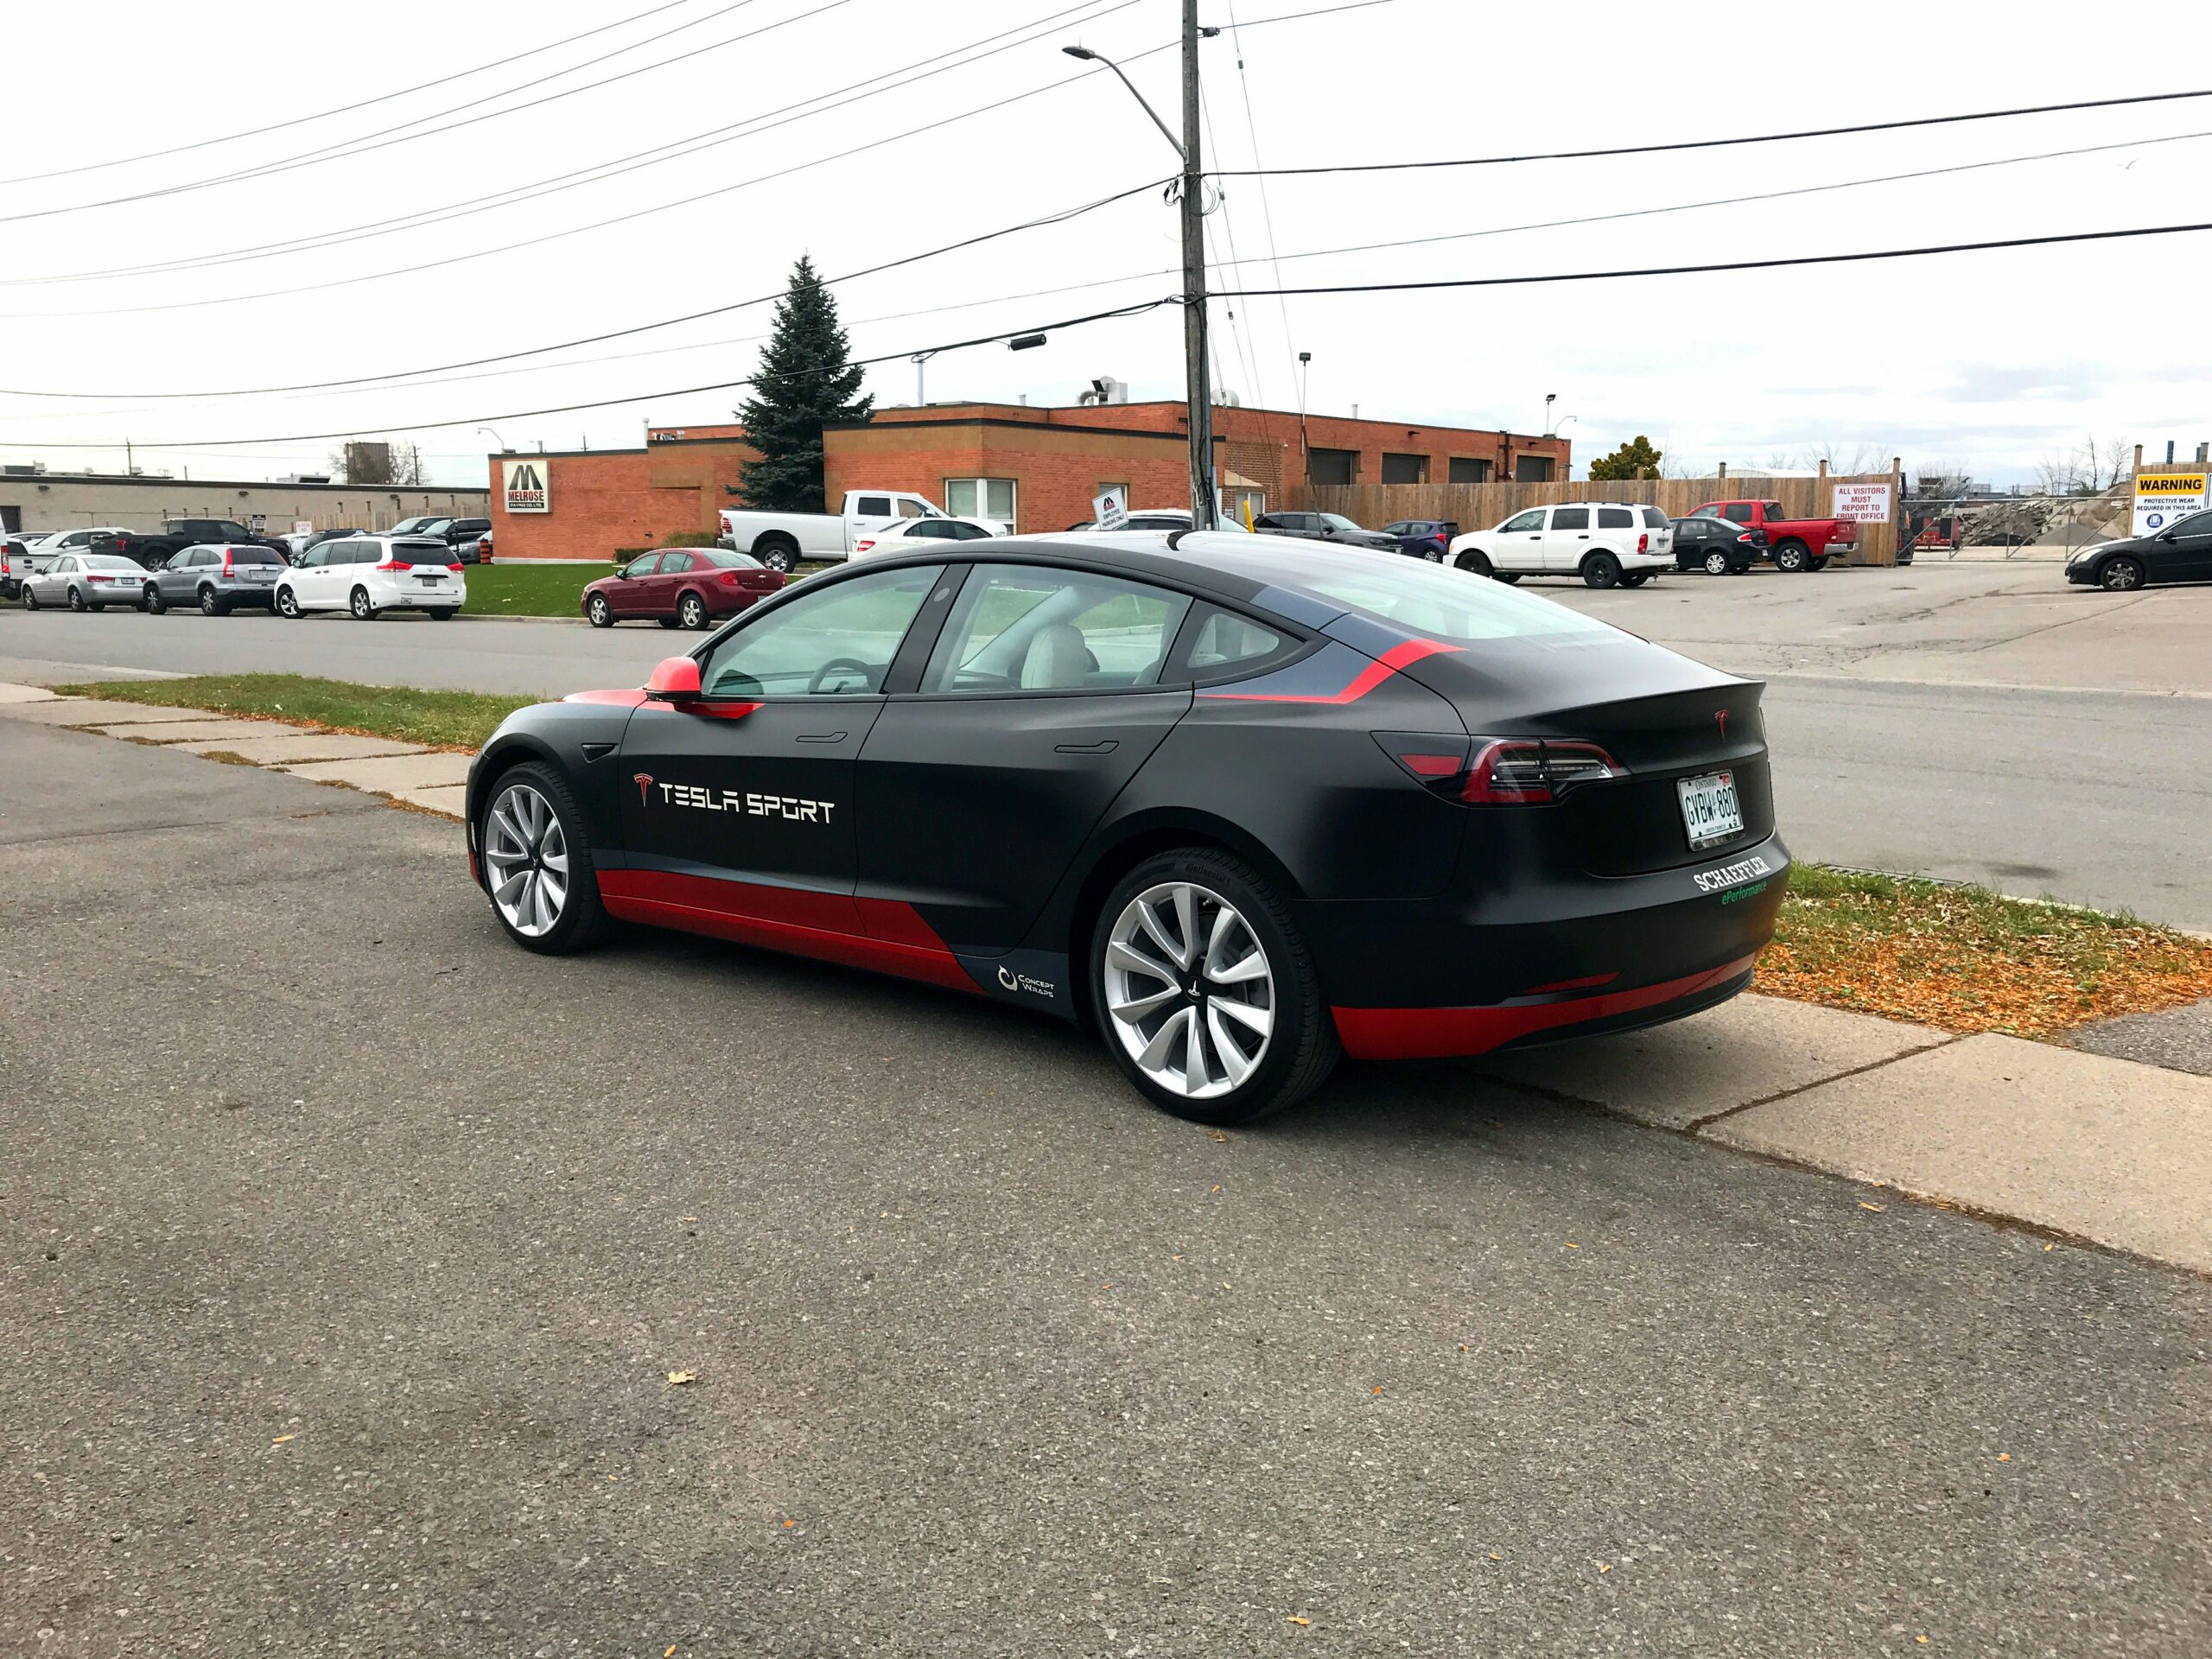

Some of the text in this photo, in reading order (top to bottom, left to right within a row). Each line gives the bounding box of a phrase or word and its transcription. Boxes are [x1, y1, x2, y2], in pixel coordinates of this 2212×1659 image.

[1853, 486, 1885, 495] VISITORS
[2139, 479, 2202, 491] WARNING
[508, 491, 544, 501] MELROSE
[658, 782, 836, 824] TESLA SPORT
[1694, 856, 1771, 892] SCHAEFFLER
[1721, 881, 1767, 905] ePerformance
